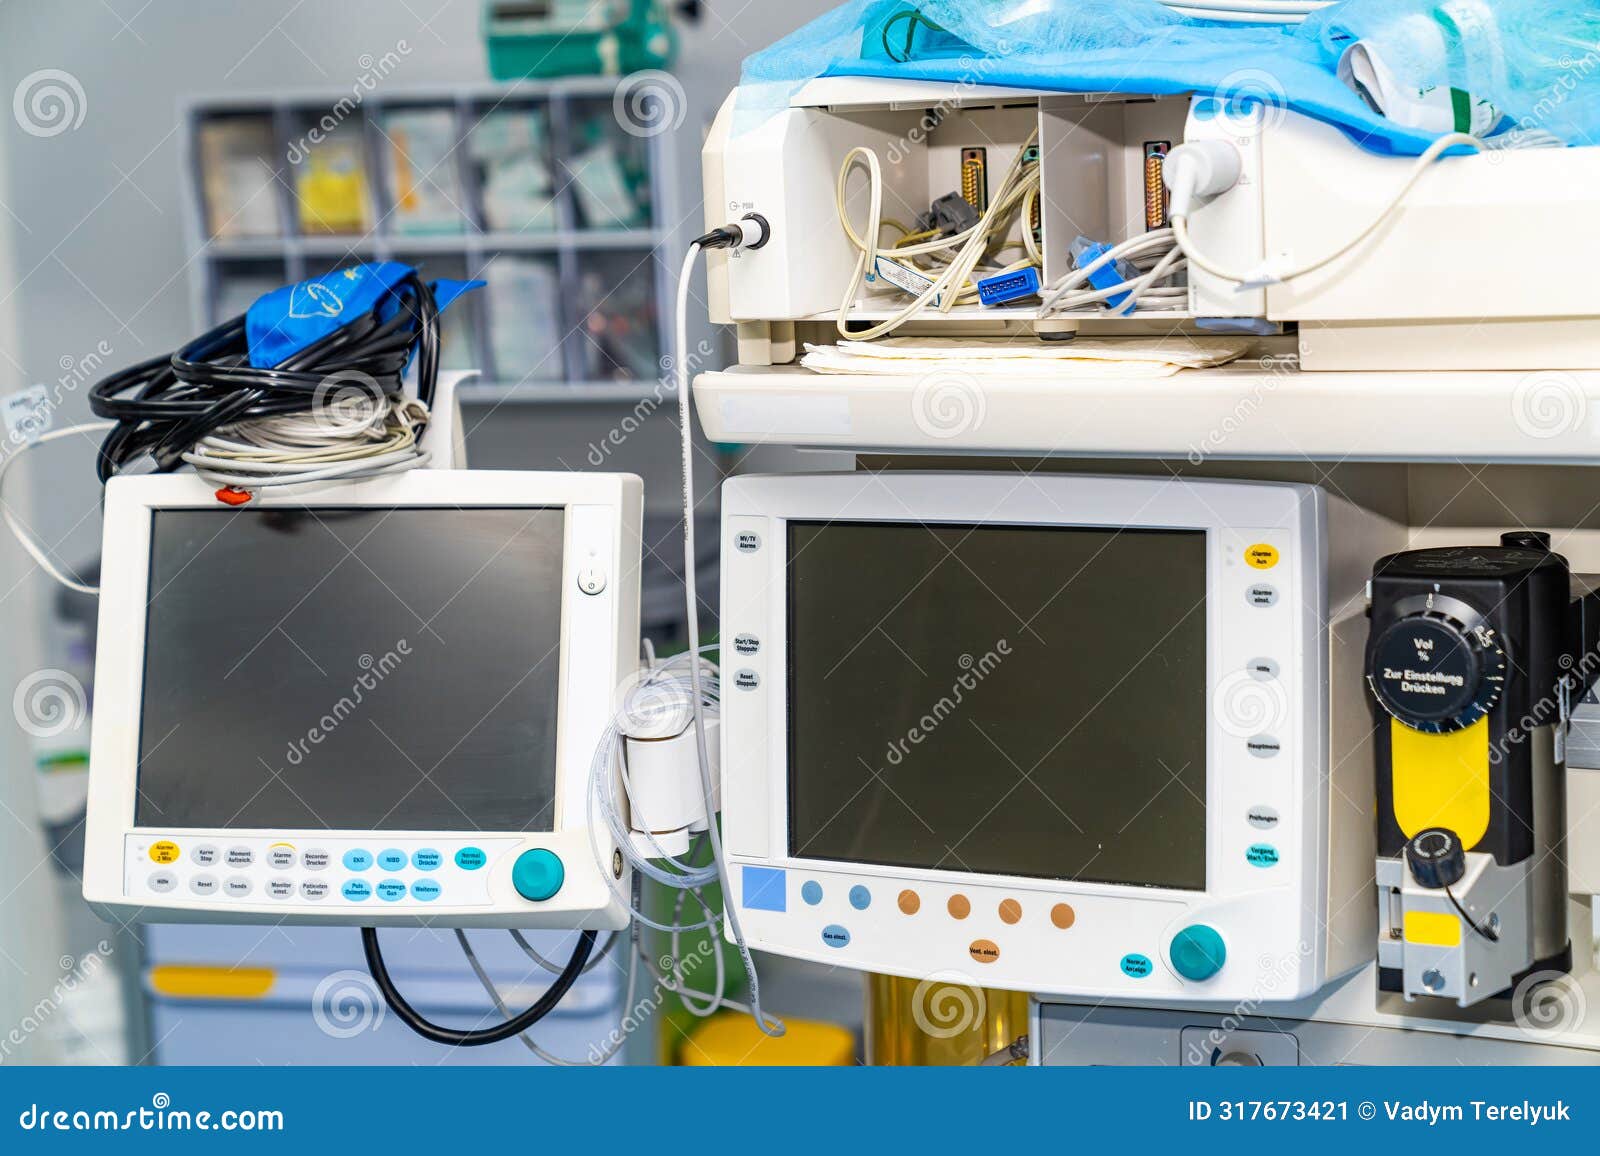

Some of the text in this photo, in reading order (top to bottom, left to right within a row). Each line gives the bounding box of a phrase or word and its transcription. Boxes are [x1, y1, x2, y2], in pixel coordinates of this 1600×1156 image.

[1413, 638, 1433, 650] Vol
[1417, 650, 1430, 661] %
[1383, 667, 1464, 687] Zur Einstellung
[1401, 680, 1446, 695] Drücken
